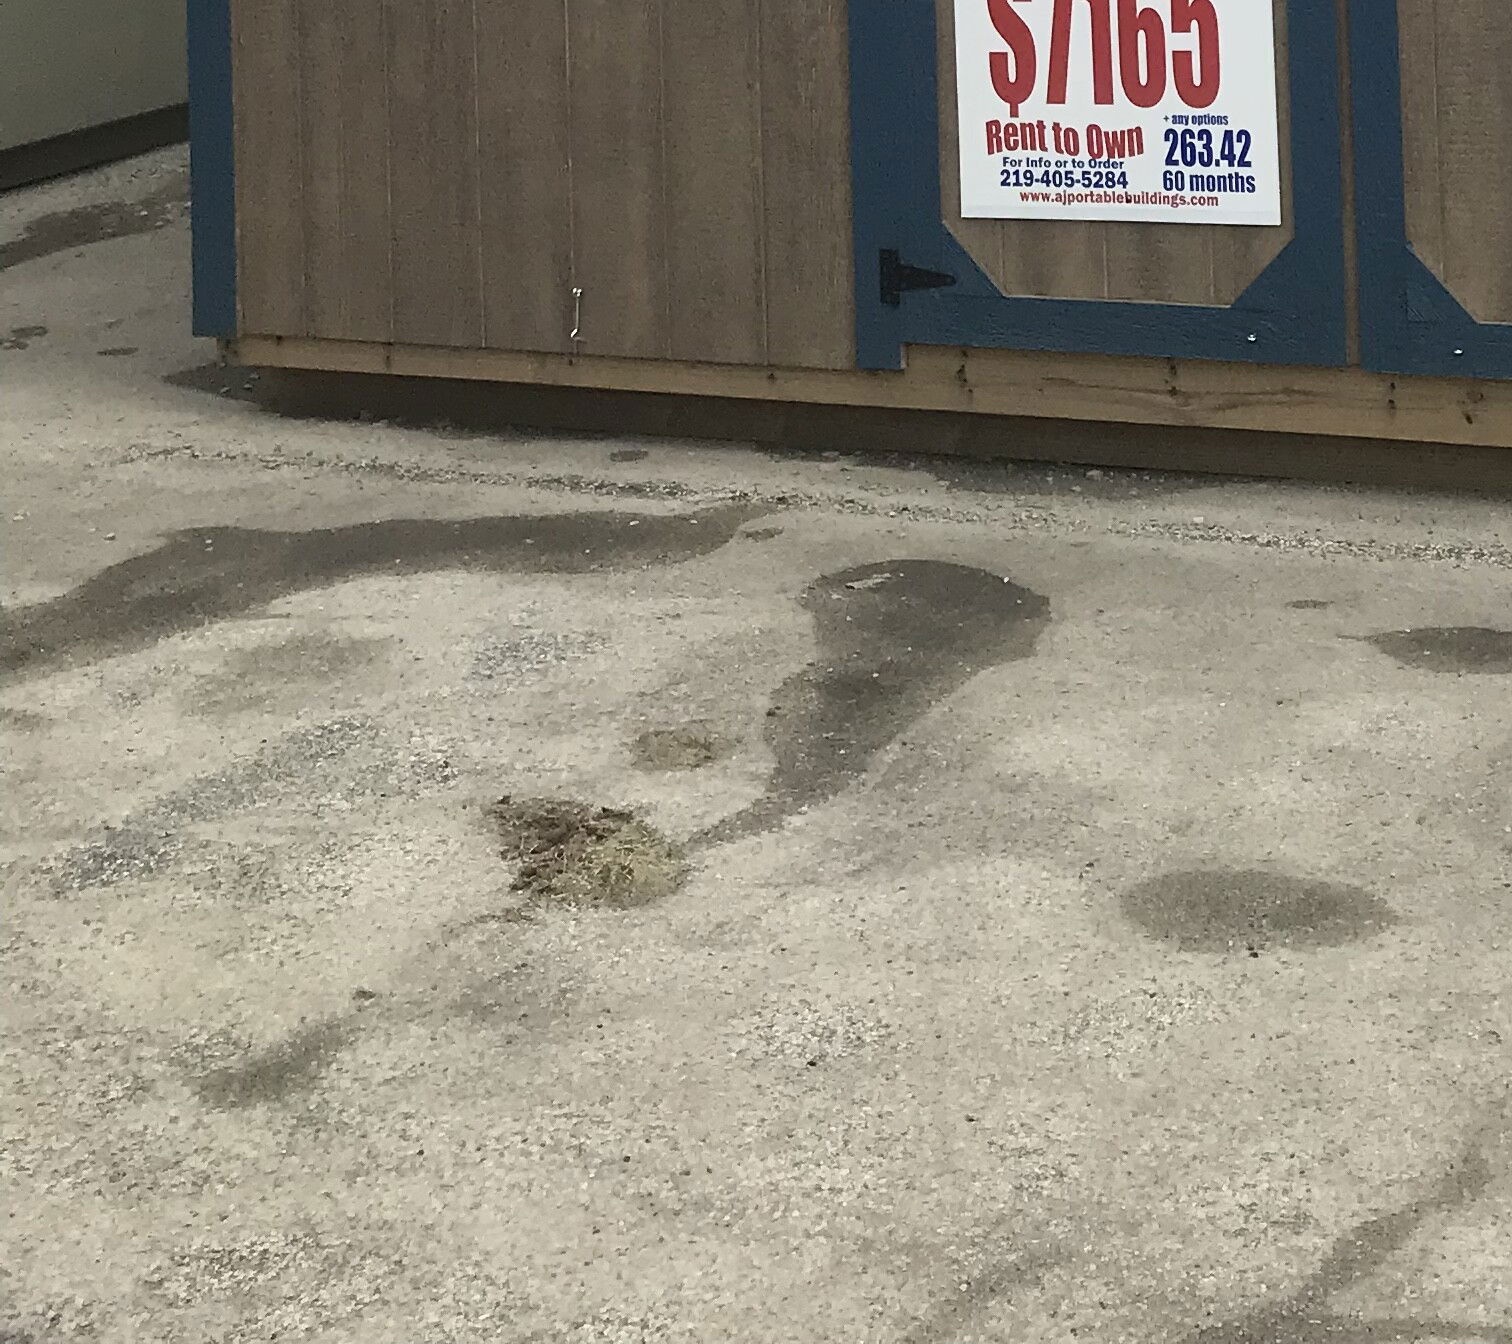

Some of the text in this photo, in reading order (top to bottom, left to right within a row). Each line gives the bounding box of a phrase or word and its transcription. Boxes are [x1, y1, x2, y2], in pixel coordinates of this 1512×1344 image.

[1171, 114, 1189, 126] any
[1191, 113, 1229, 126] options
[985, 119, 1144, 159] Rent to Own
[1164, 128, 1252, 168] 263.42
[1002, 157, 1124, 169] For Info or to Order
[1000, 169, 1128, 189] 219-405-5284
[1162, 170, 1256, 193] 60 months
[1020, 190, 1219, 208] www.ajportablebuildings.com
